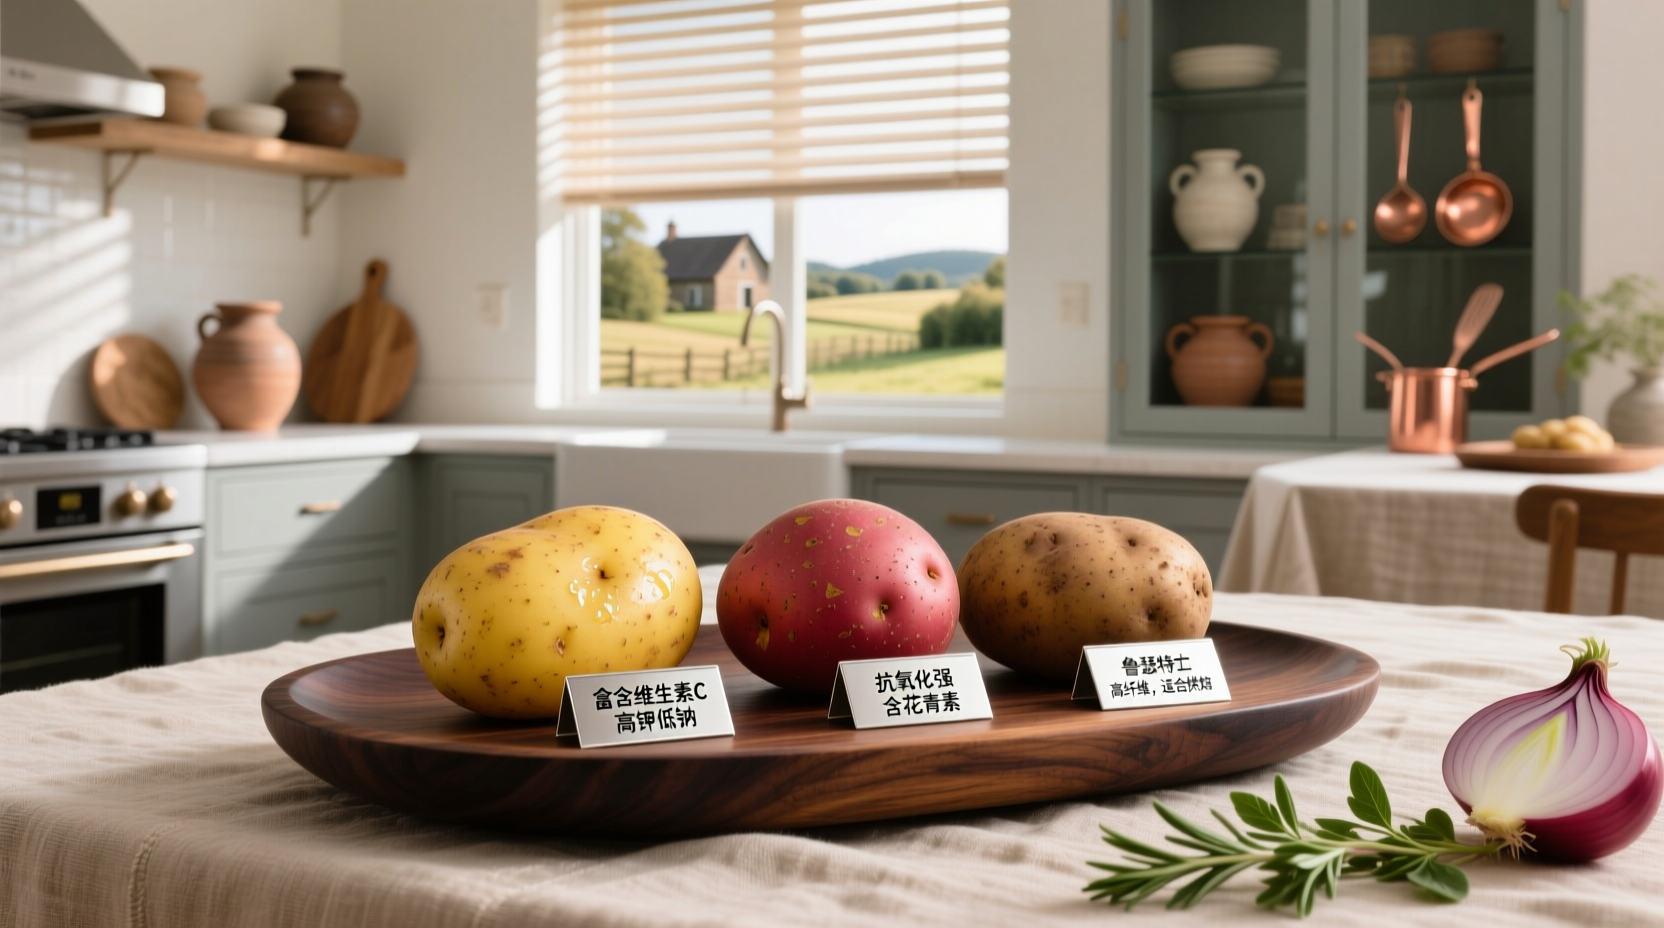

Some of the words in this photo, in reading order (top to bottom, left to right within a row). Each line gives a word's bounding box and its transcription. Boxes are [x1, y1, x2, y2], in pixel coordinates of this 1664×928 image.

[875, 668, 954, 693] 抗氧化强
[883, 691, 961, 717] 含花青素
